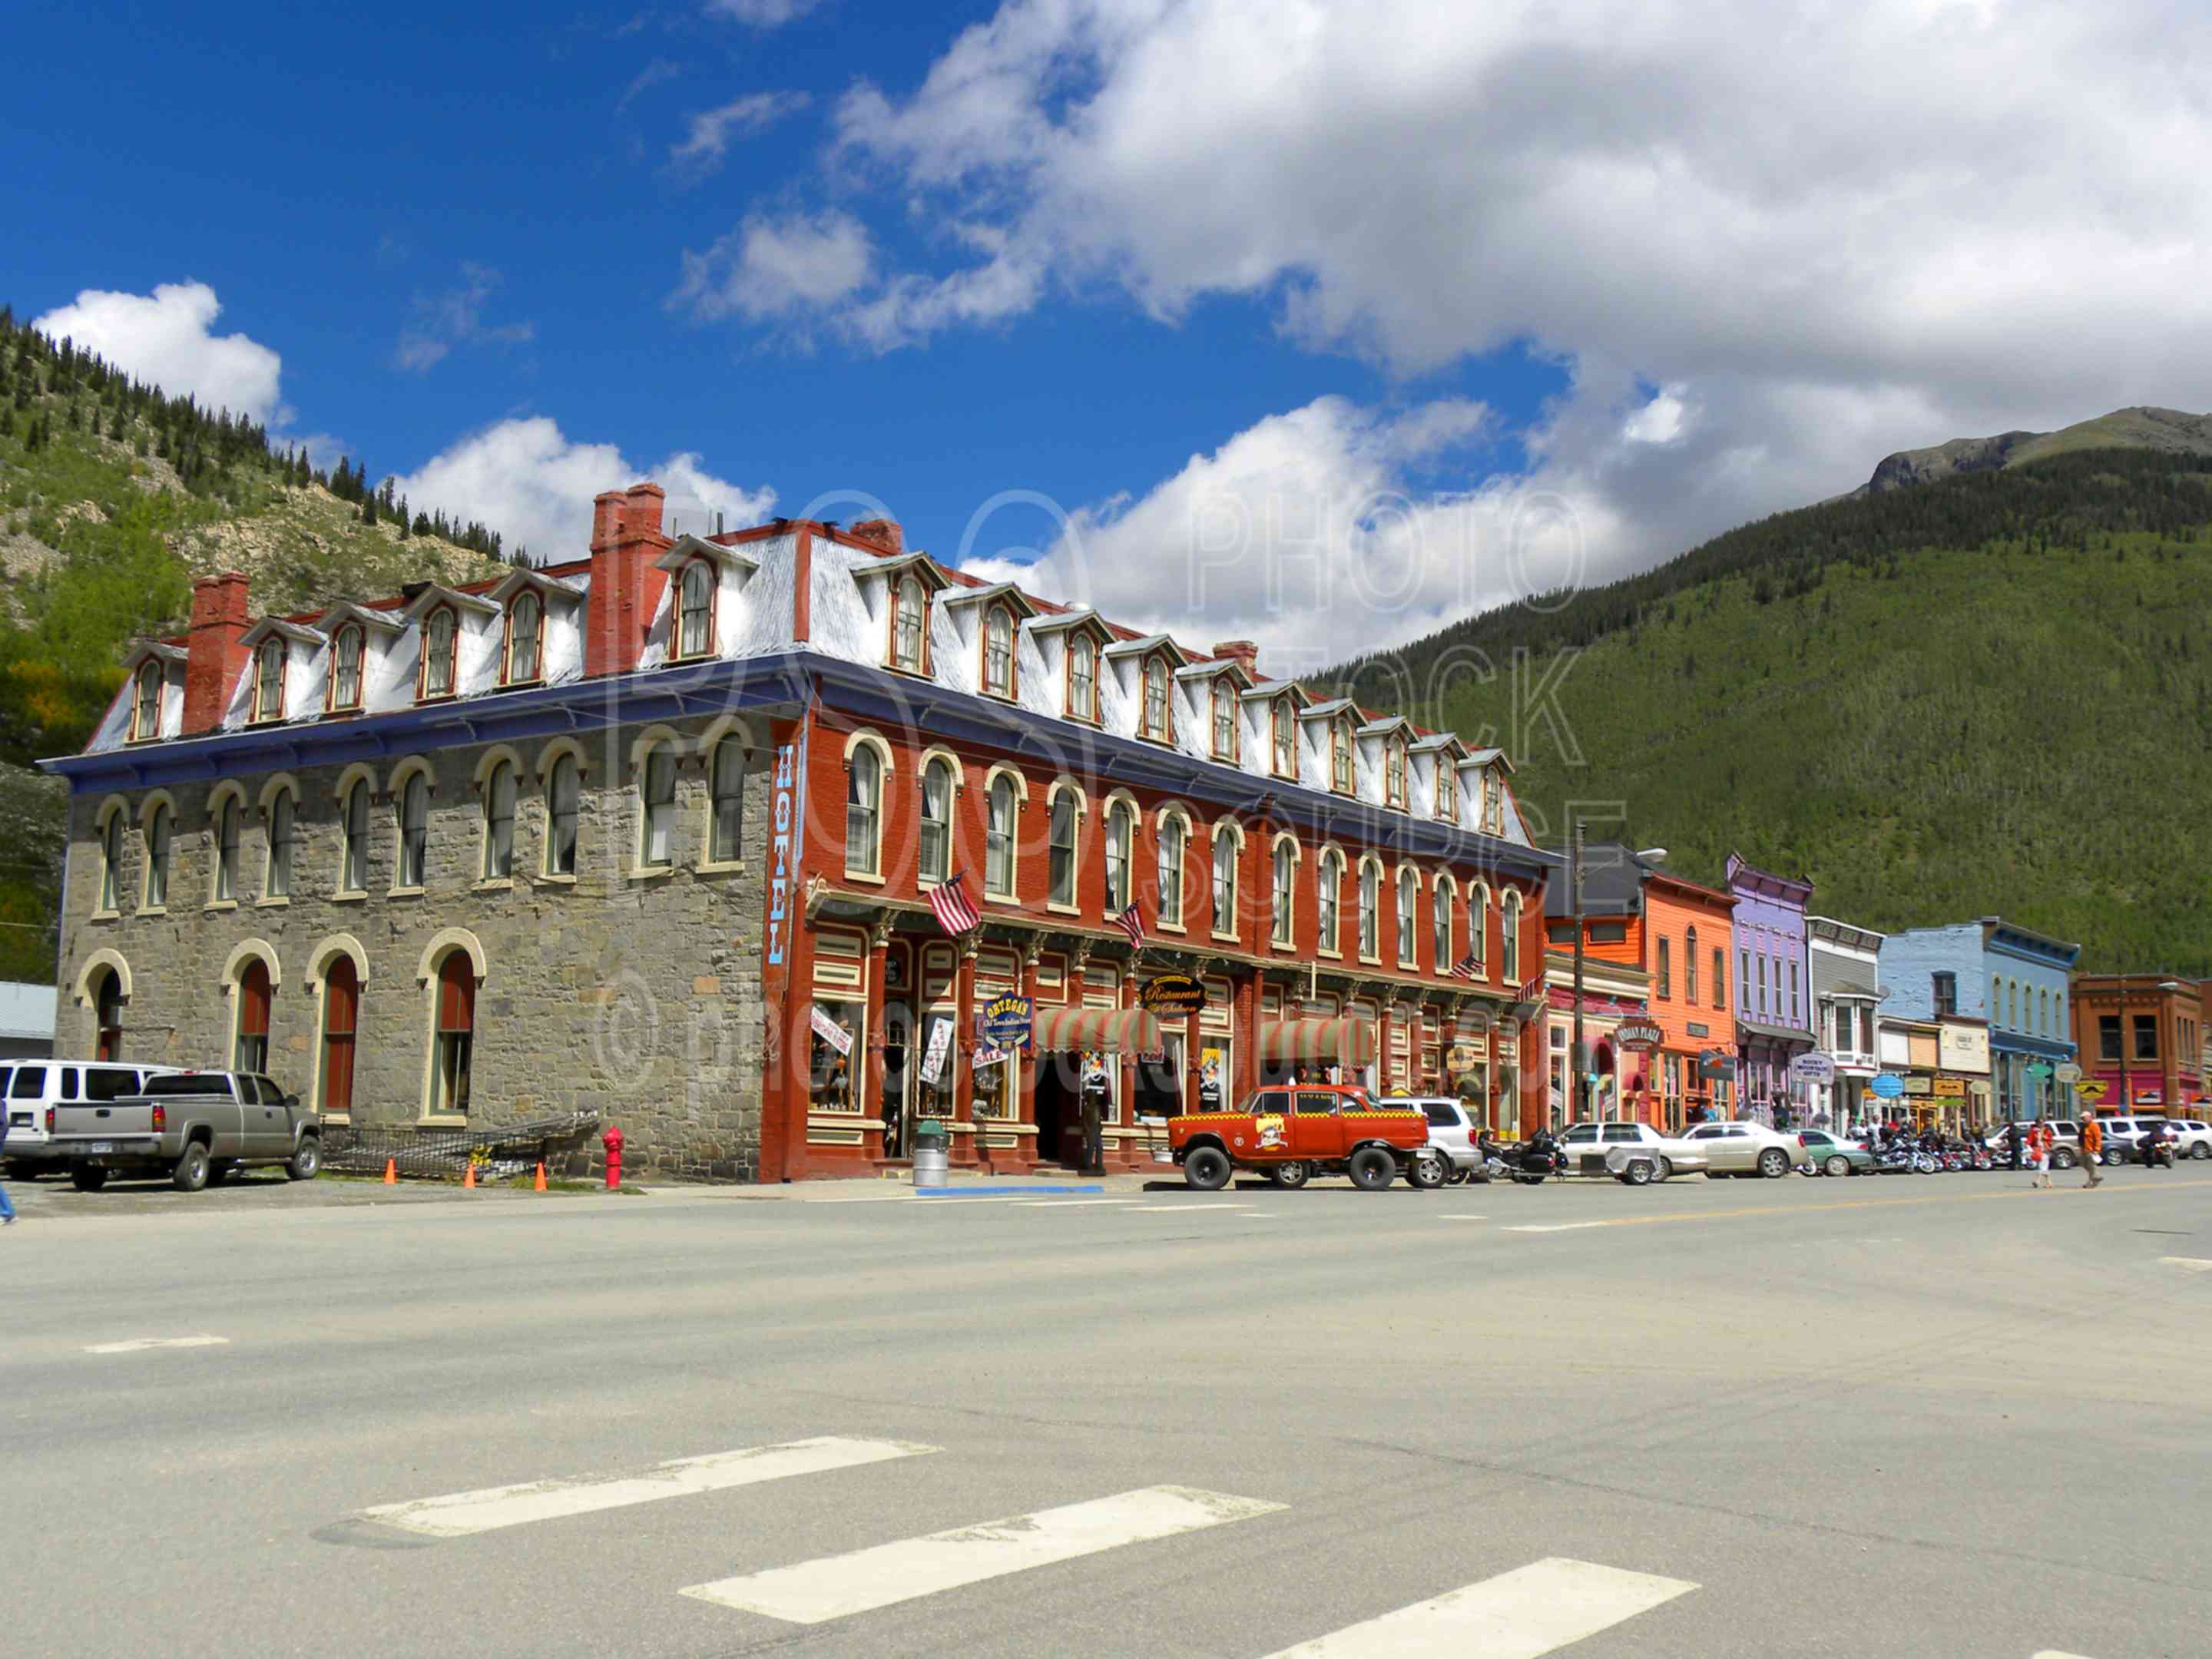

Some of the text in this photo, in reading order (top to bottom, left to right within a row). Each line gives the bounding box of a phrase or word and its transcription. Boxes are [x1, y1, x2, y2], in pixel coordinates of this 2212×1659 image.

[769, 745, 793, 965] HOTEL
[1145, 985, 1201, 1001] Restaurant
[975, 1049, 1003, 1065] SALE
